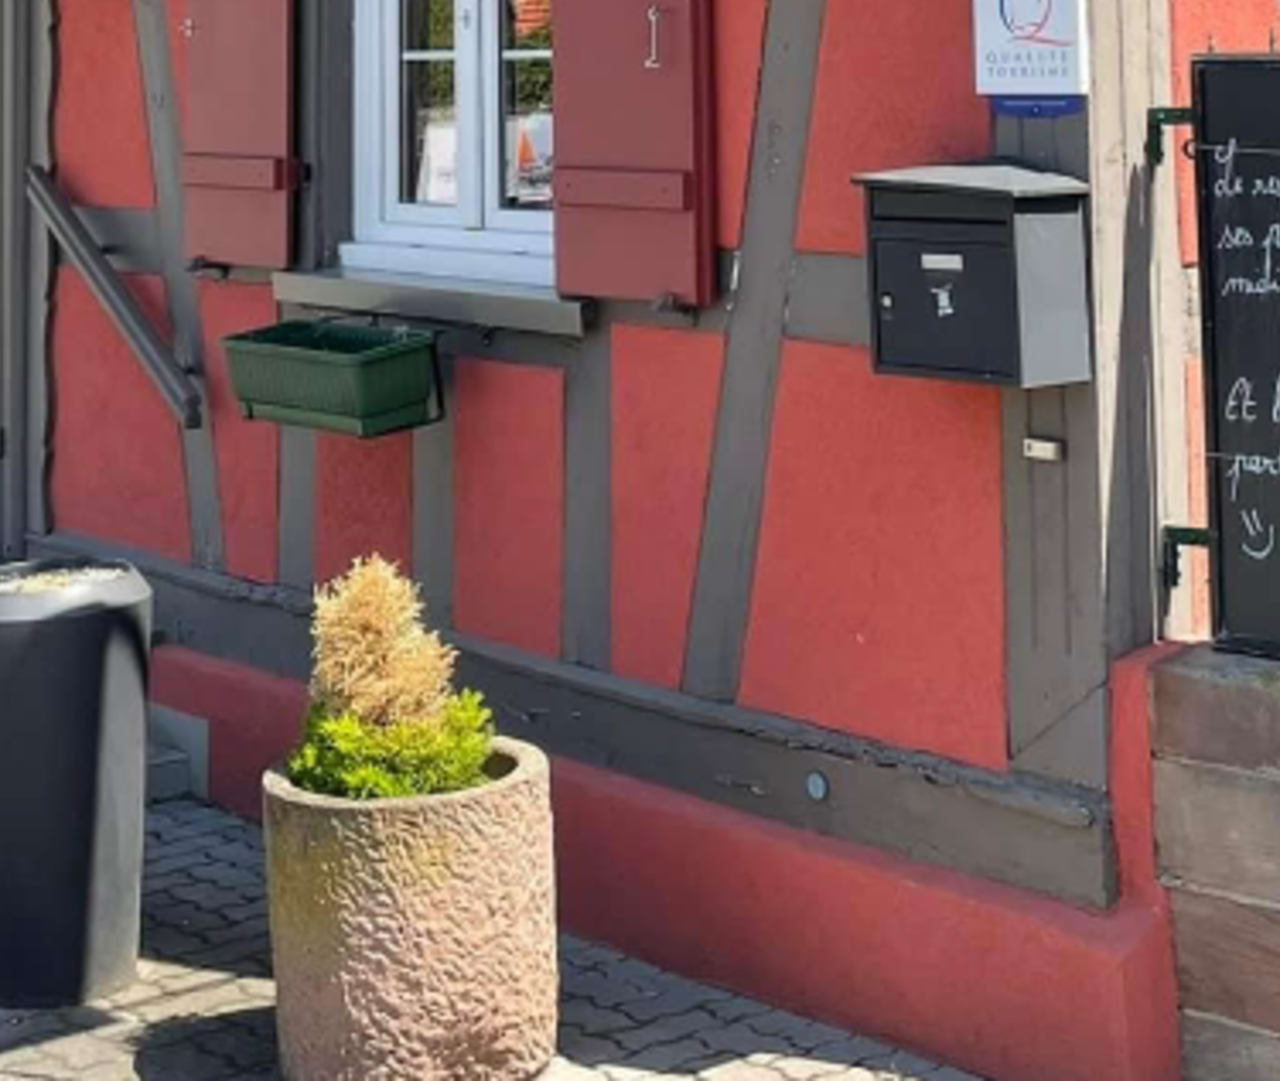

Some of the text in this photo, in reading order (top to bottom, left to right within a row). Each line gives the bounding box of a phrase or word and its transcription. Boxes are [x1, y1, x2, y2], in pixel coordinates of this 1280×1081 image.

[1214, 137, 1243, 198] Le
[1217, 223, 1254, 250] ses
[1224, 376, 1258, 422] Et
